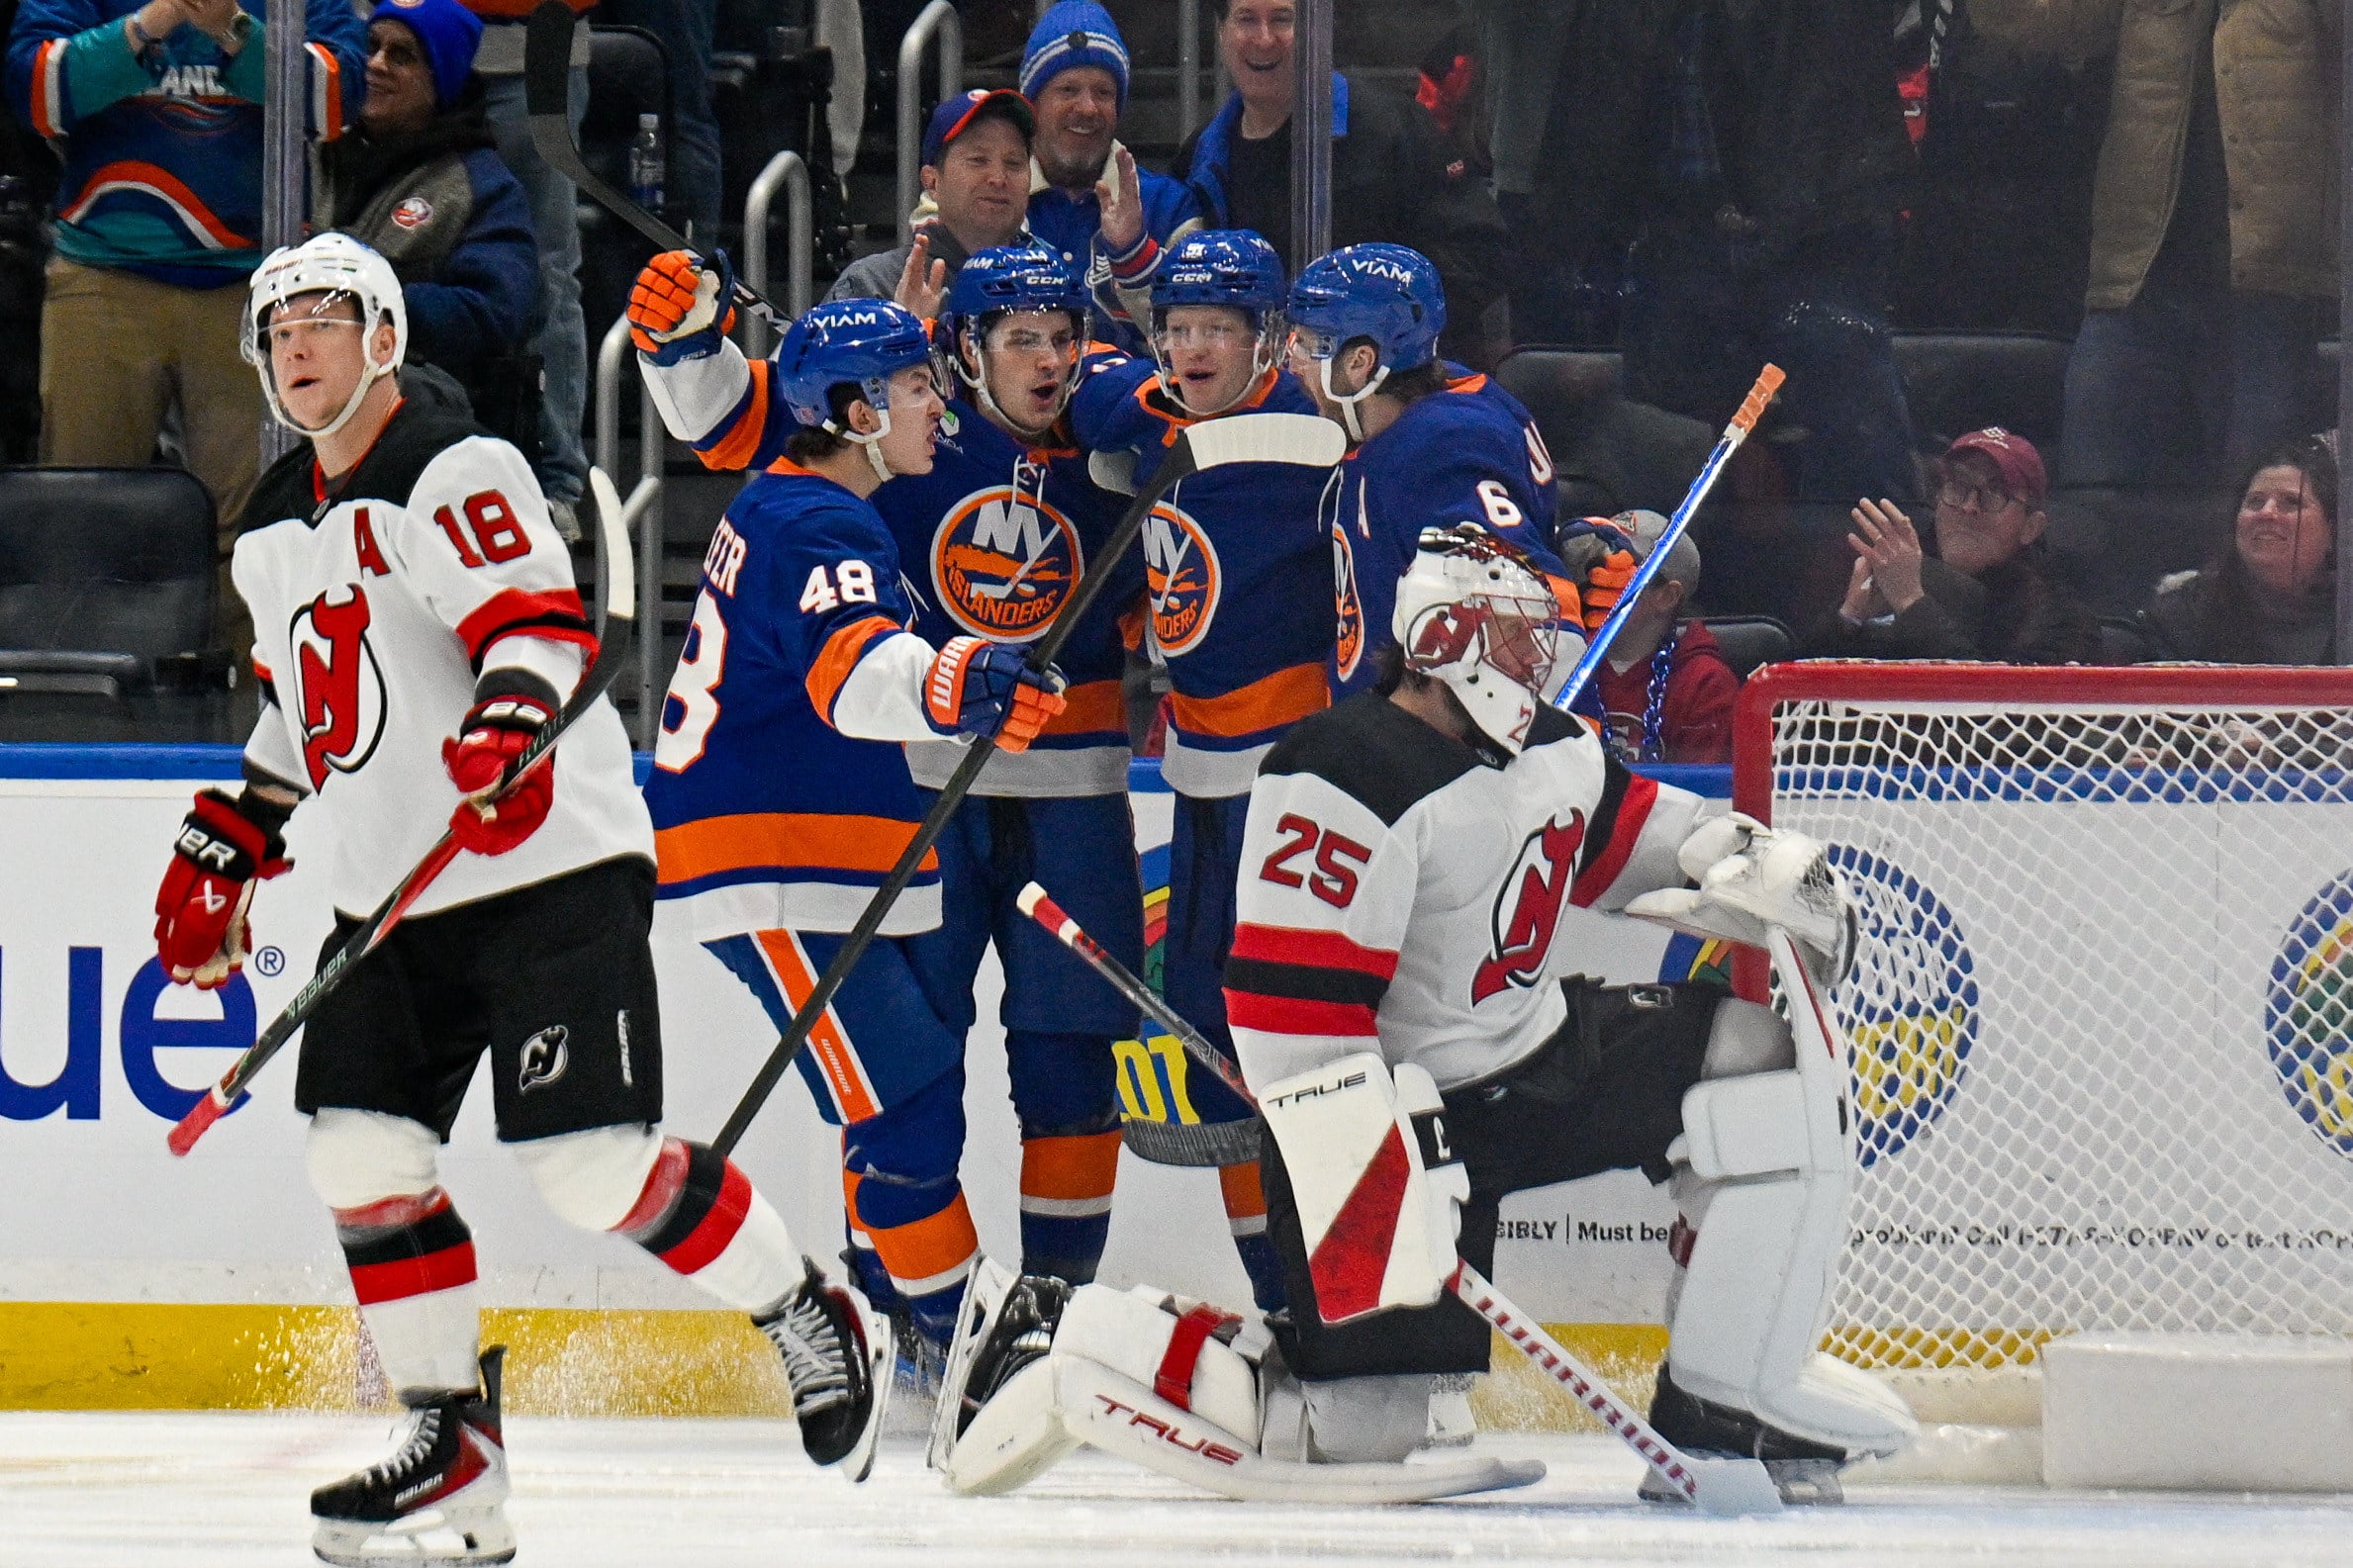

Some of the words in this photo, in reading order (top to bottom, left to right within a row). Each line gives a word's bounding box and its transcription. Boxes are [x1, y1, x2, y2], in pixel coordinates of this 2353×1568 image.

[1026, 275, 1066, 285] CCM
[1172, 273, 1213, 284] CCM
[1352, 259, 1412, 285] VIAM
[812, 312, 877, 328] VIAM
[433, 489, 532, 569] 18
[1475, 479, 1524, 528] 6
[354, 507, 390, 580] A
[799, 559, 878, 614] 48
[948, 563, 1059, 626] ISLANDERS
[1259, 812, 1372, 910] 25
[1267, 1071, 1366, 1108] TRUE
[1577, 1221, 1634, 1243] Must
[1640, 1221, 1668, 1243] be
[1476, 1295, 1698, 1499] WARRIOR
[1094, 1394, 1244, 1466] TRUE
